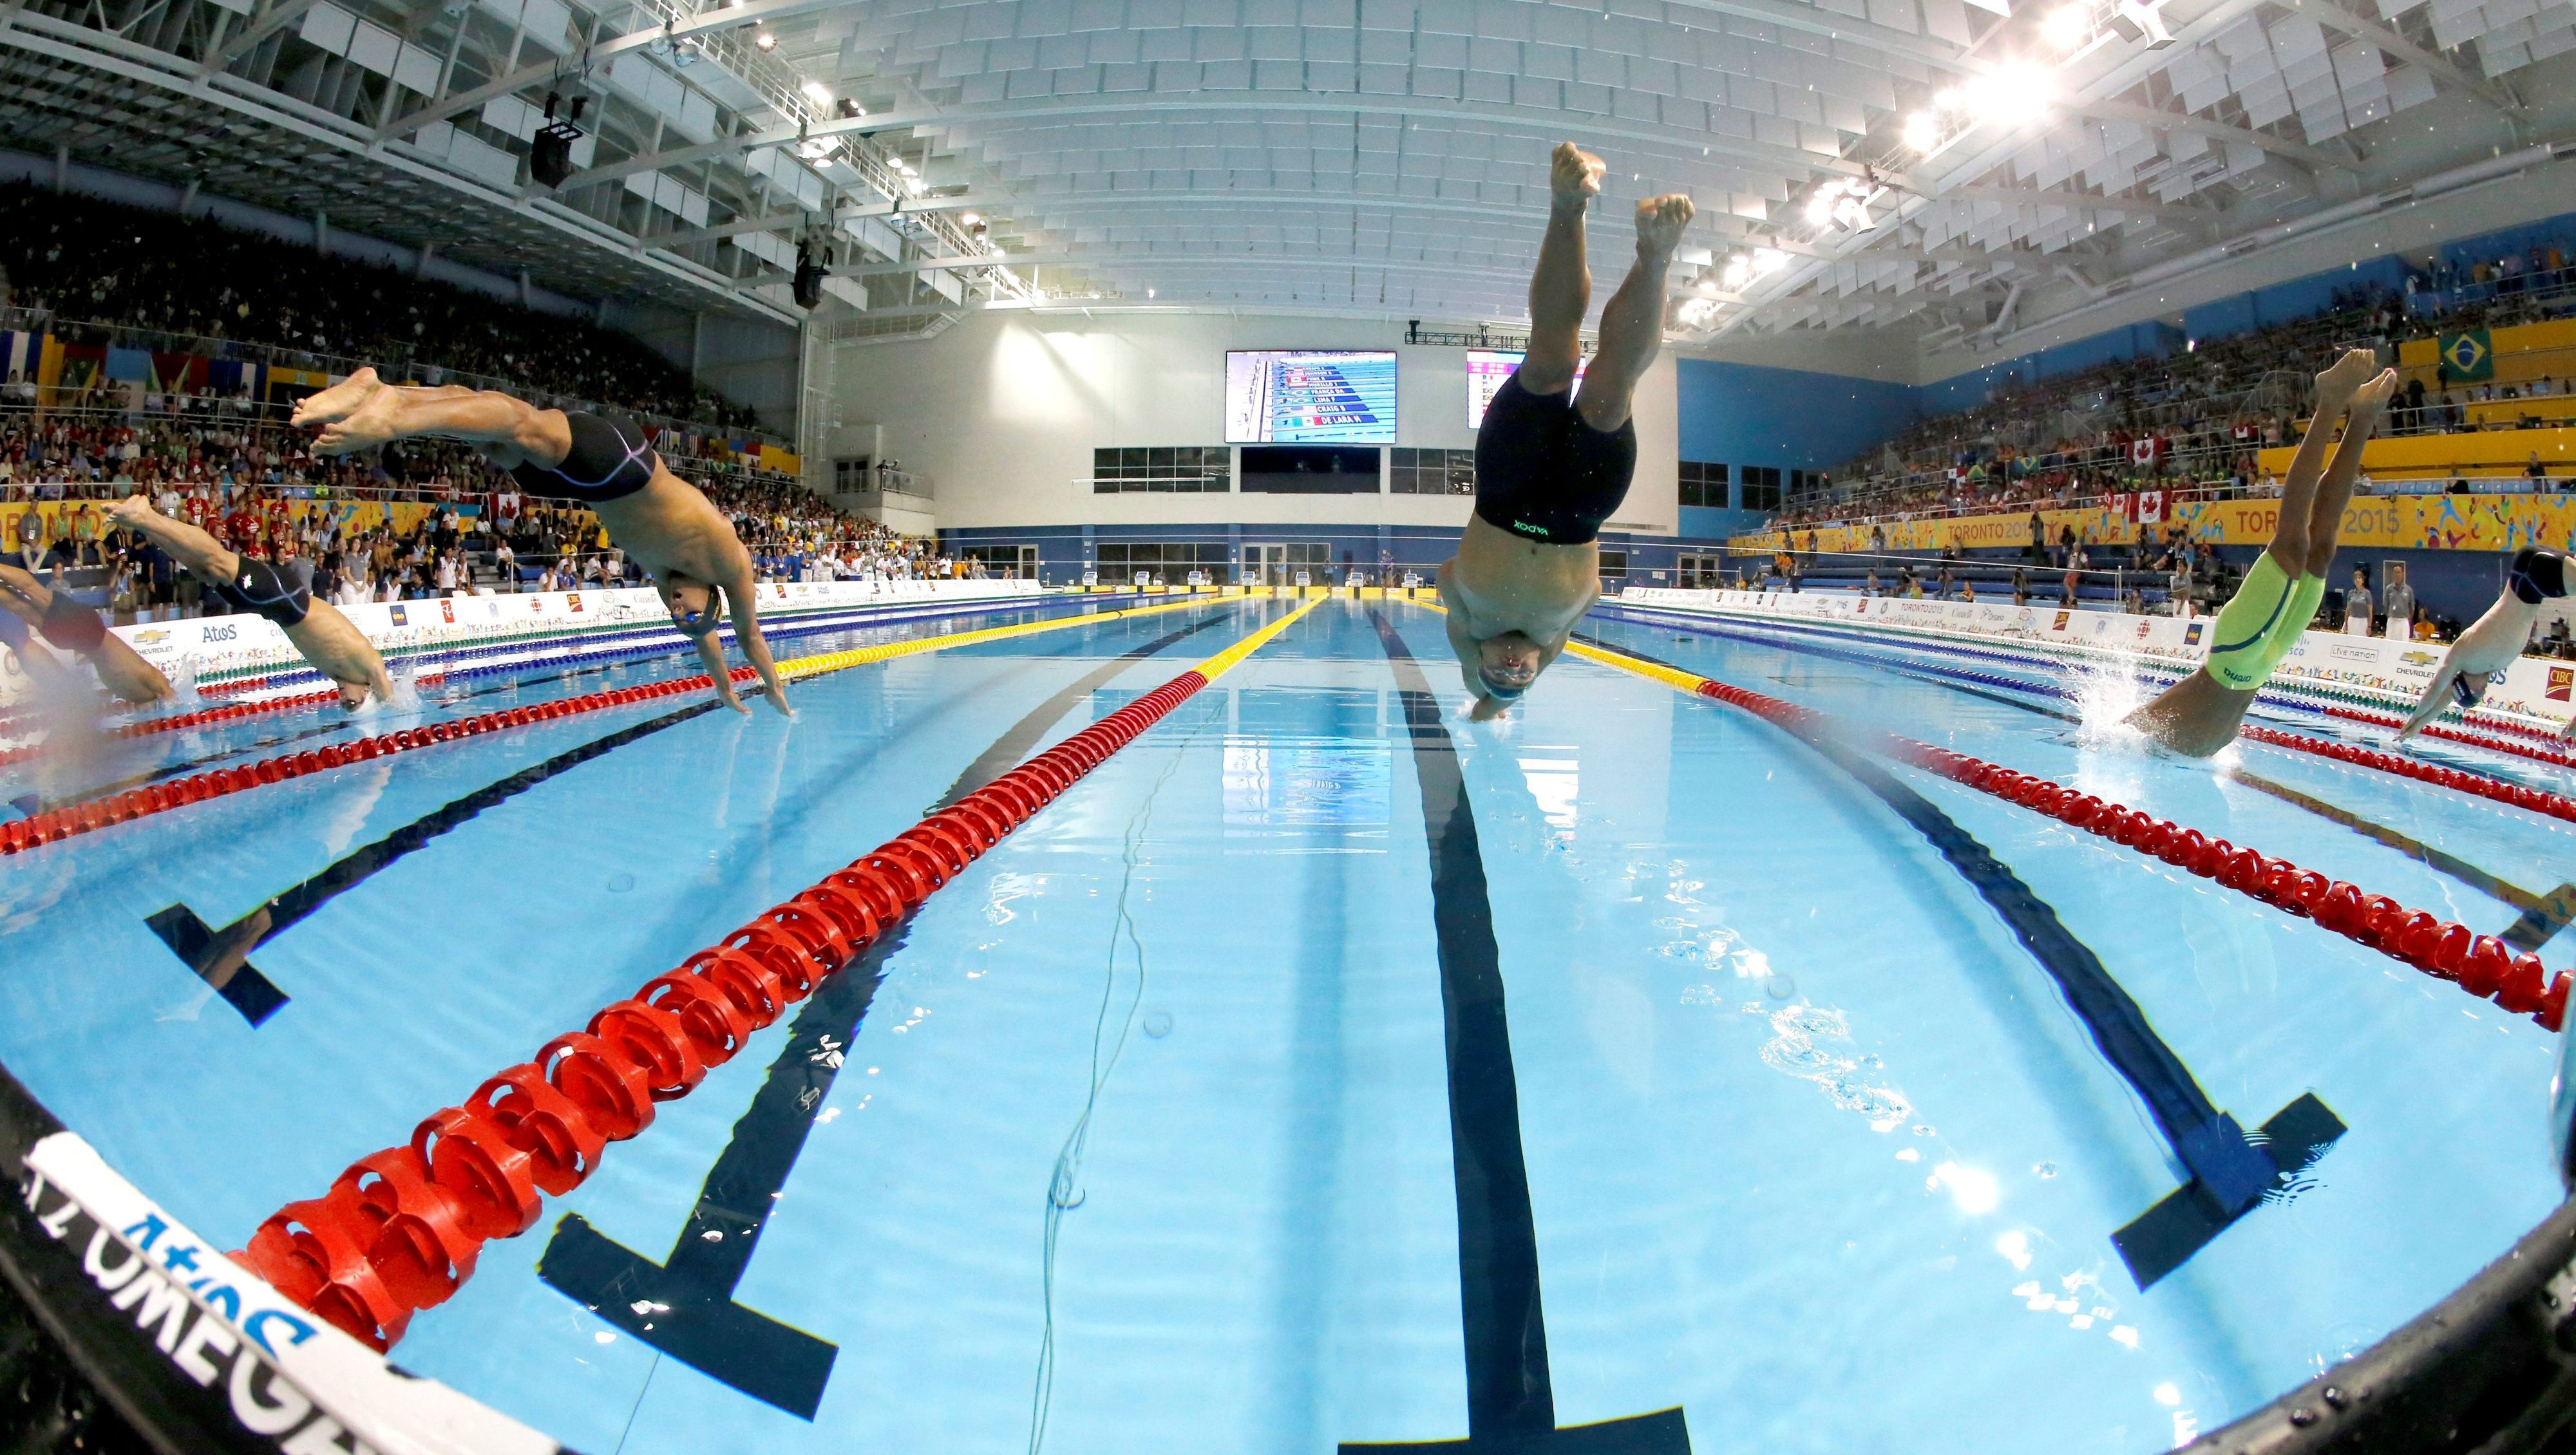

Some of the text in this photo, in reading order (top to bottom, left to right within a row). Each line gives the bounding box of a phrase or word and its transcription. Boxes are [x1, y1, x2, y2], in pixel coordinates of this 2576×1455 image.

[1332, 415, 1352, 424] LARA
[1513, 520, 1548, 536] VADOX
[2344, 509, 2400, 534] 2015
[1948, 523, 2003, 541] TORONTO
[2224, 668, 2251, 682] arena
[2396, 666, 2436, 679] CHEVROLET
[2549, 670, 2573, 684] CIBC
